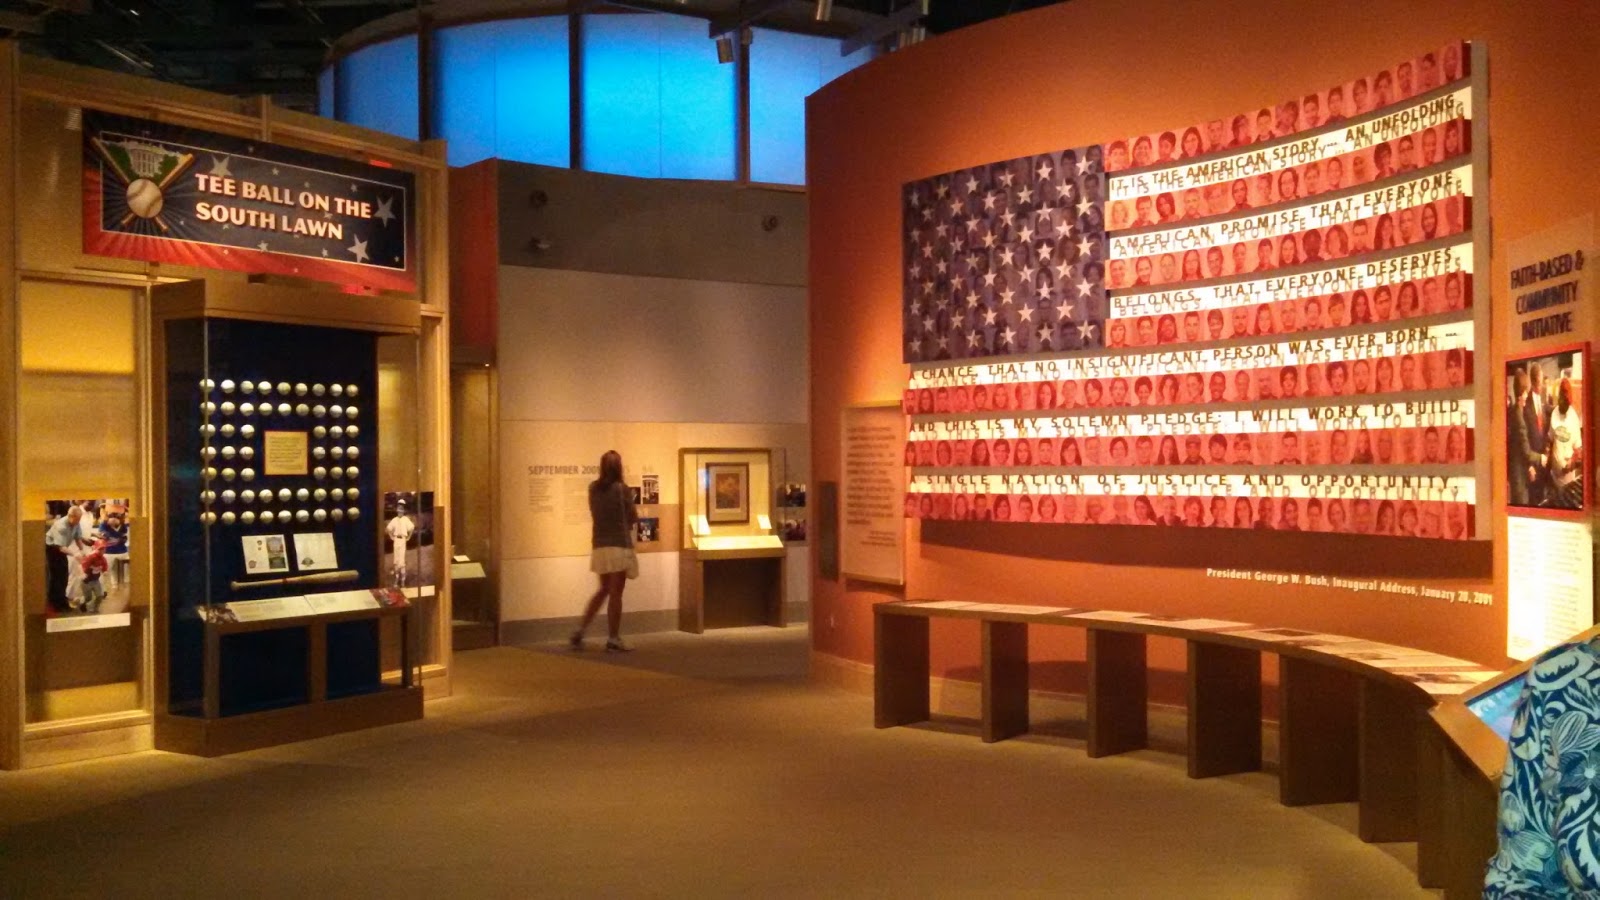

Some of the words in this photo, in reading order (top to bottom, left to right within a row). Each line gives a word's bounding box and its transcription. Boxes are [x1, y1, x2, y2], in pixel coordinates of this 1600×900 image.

[1111, 180, 1123, 190] IT
[1132, 175, 1144, 187] IS
[1152, 169, 1179, 184] THE
[1186, 151, 1265, 178] AMERICAN
[1273, 138, 1319, 159] STORY
[1345, 124, 1366, 142] AN
[1372, 94, 1455, 133] UNFOLDING
[195, 174, 236, 196] TEE
[242, 182, 294, 206] BALL
[299, 191, 330, 212] ON
[334, 197, 372, 219] THE
[1114, 226, 1209, 249] AMERICAN
[1221, 210, 1299, 234] PROMISE
[1311, 198, 1353, 218] THAT
[1364, 171, 1453, 206] EVERYONE
[196, 202, 276, 230] SOUTH
[282, 215, 343, 240] LAWN
[1214, 283, 1255, 298] THAT
[1266, 267, 1357, 291] EVERYONE
[988, 363, 1028, 375] THAT
[1035, 361, 1057, 372] NO
[1068, 352, 1203, 370] INSIGNIFICANT
[1213, 344, 1278, 361] PERSON
[1289, 340, 1324, 354] WAS
[1334, 335, 1376, 349] EVER
[909, 422, 935, 432] AND
[945, 420, 977, 431] THIS
[987, 419, 1000, 430] IS
[1014, 418, 1038, 428] MY
[1052, 415, 1128, 428] SOLEMN
[1252, 409, 1294, 422] WILL
[1309, 406, 1360, 420] WORK
[1373, 404, 1394, 417] TO
[1406, 401, 1459, 415] BUILD
[528, 465, 579, 475] SEPTEMBER
[927, 475, 988, 485] SINGLE
[1002, 475, 1080, 485] NATION
[1098, 475, 1122, 485] OF
[1138, 474, 1227, 485] JUSTICE
[1243, 475, 1284, 486] AND
[1207, 568, 1251, 580] President
[1254, 571, 1289, 584] George
[1291, 574, 1302, 584] W.
[1305, 575, 1330, 587] Bush,
[1333, 577, 1378, 591] Inaugural
[1380, 581, 1418, 597] Address,
[1421, 586, 1455, 603] January
